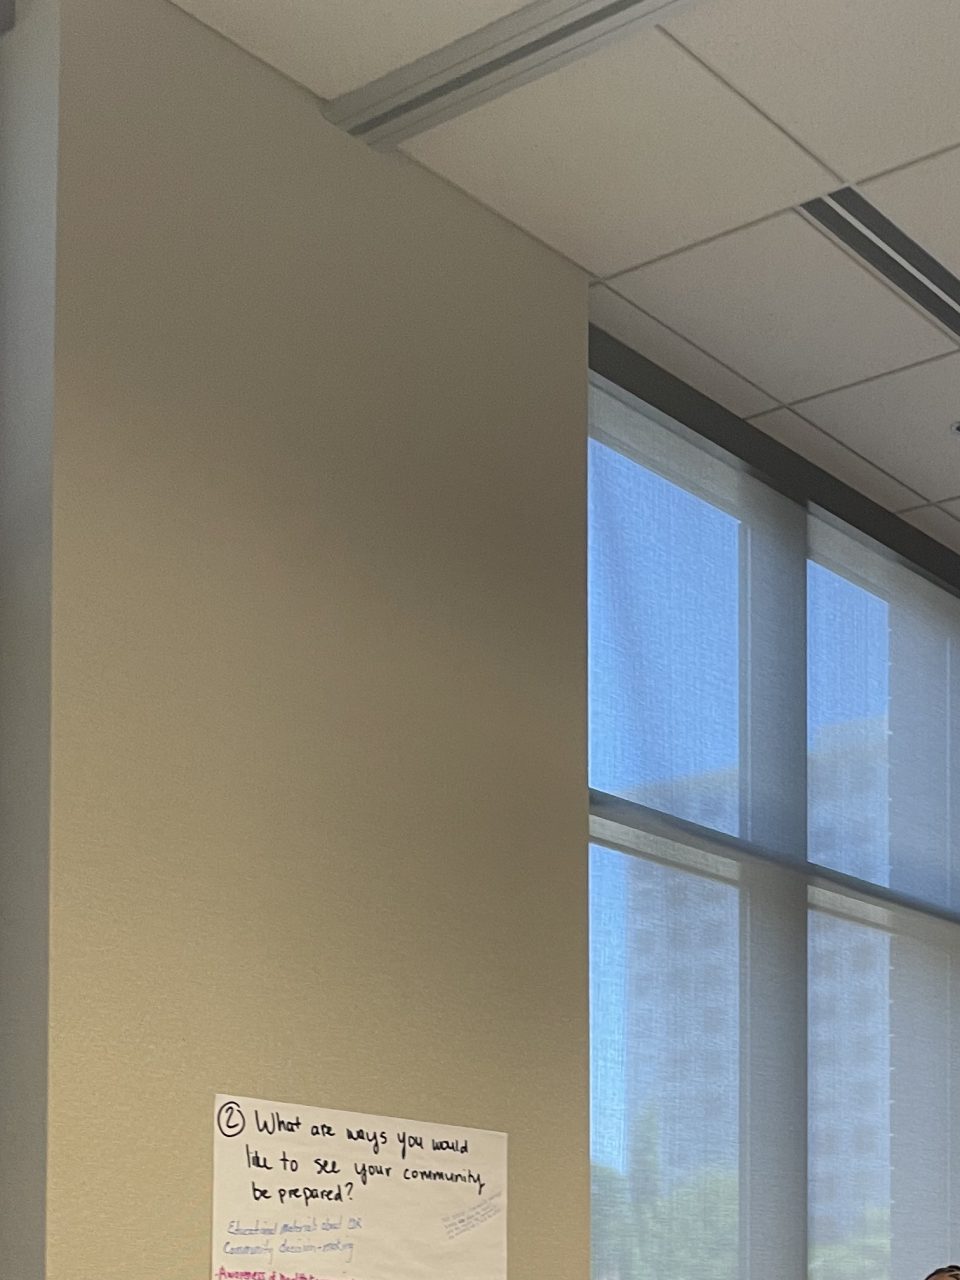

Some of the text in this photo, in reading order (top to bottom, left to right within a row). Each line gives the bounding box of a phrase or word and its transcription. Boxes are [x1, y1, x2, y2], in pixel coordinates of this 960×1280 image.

[255, 1110, 302, 1135] What
[311, 1124, 336, 1137] are
[346, 1128, 388, 1154] ways
[397, 1132, 424, 1160] you
[432, 1138, 469, 1154] would
[252, 1181, 354, 1207] be prepared?
[280, 1151, 299, 1172] to
[314, 1157, 341, 1175] see
[354, 1163, 392, 1186] your
[403, 1169, 486, 1195] community
